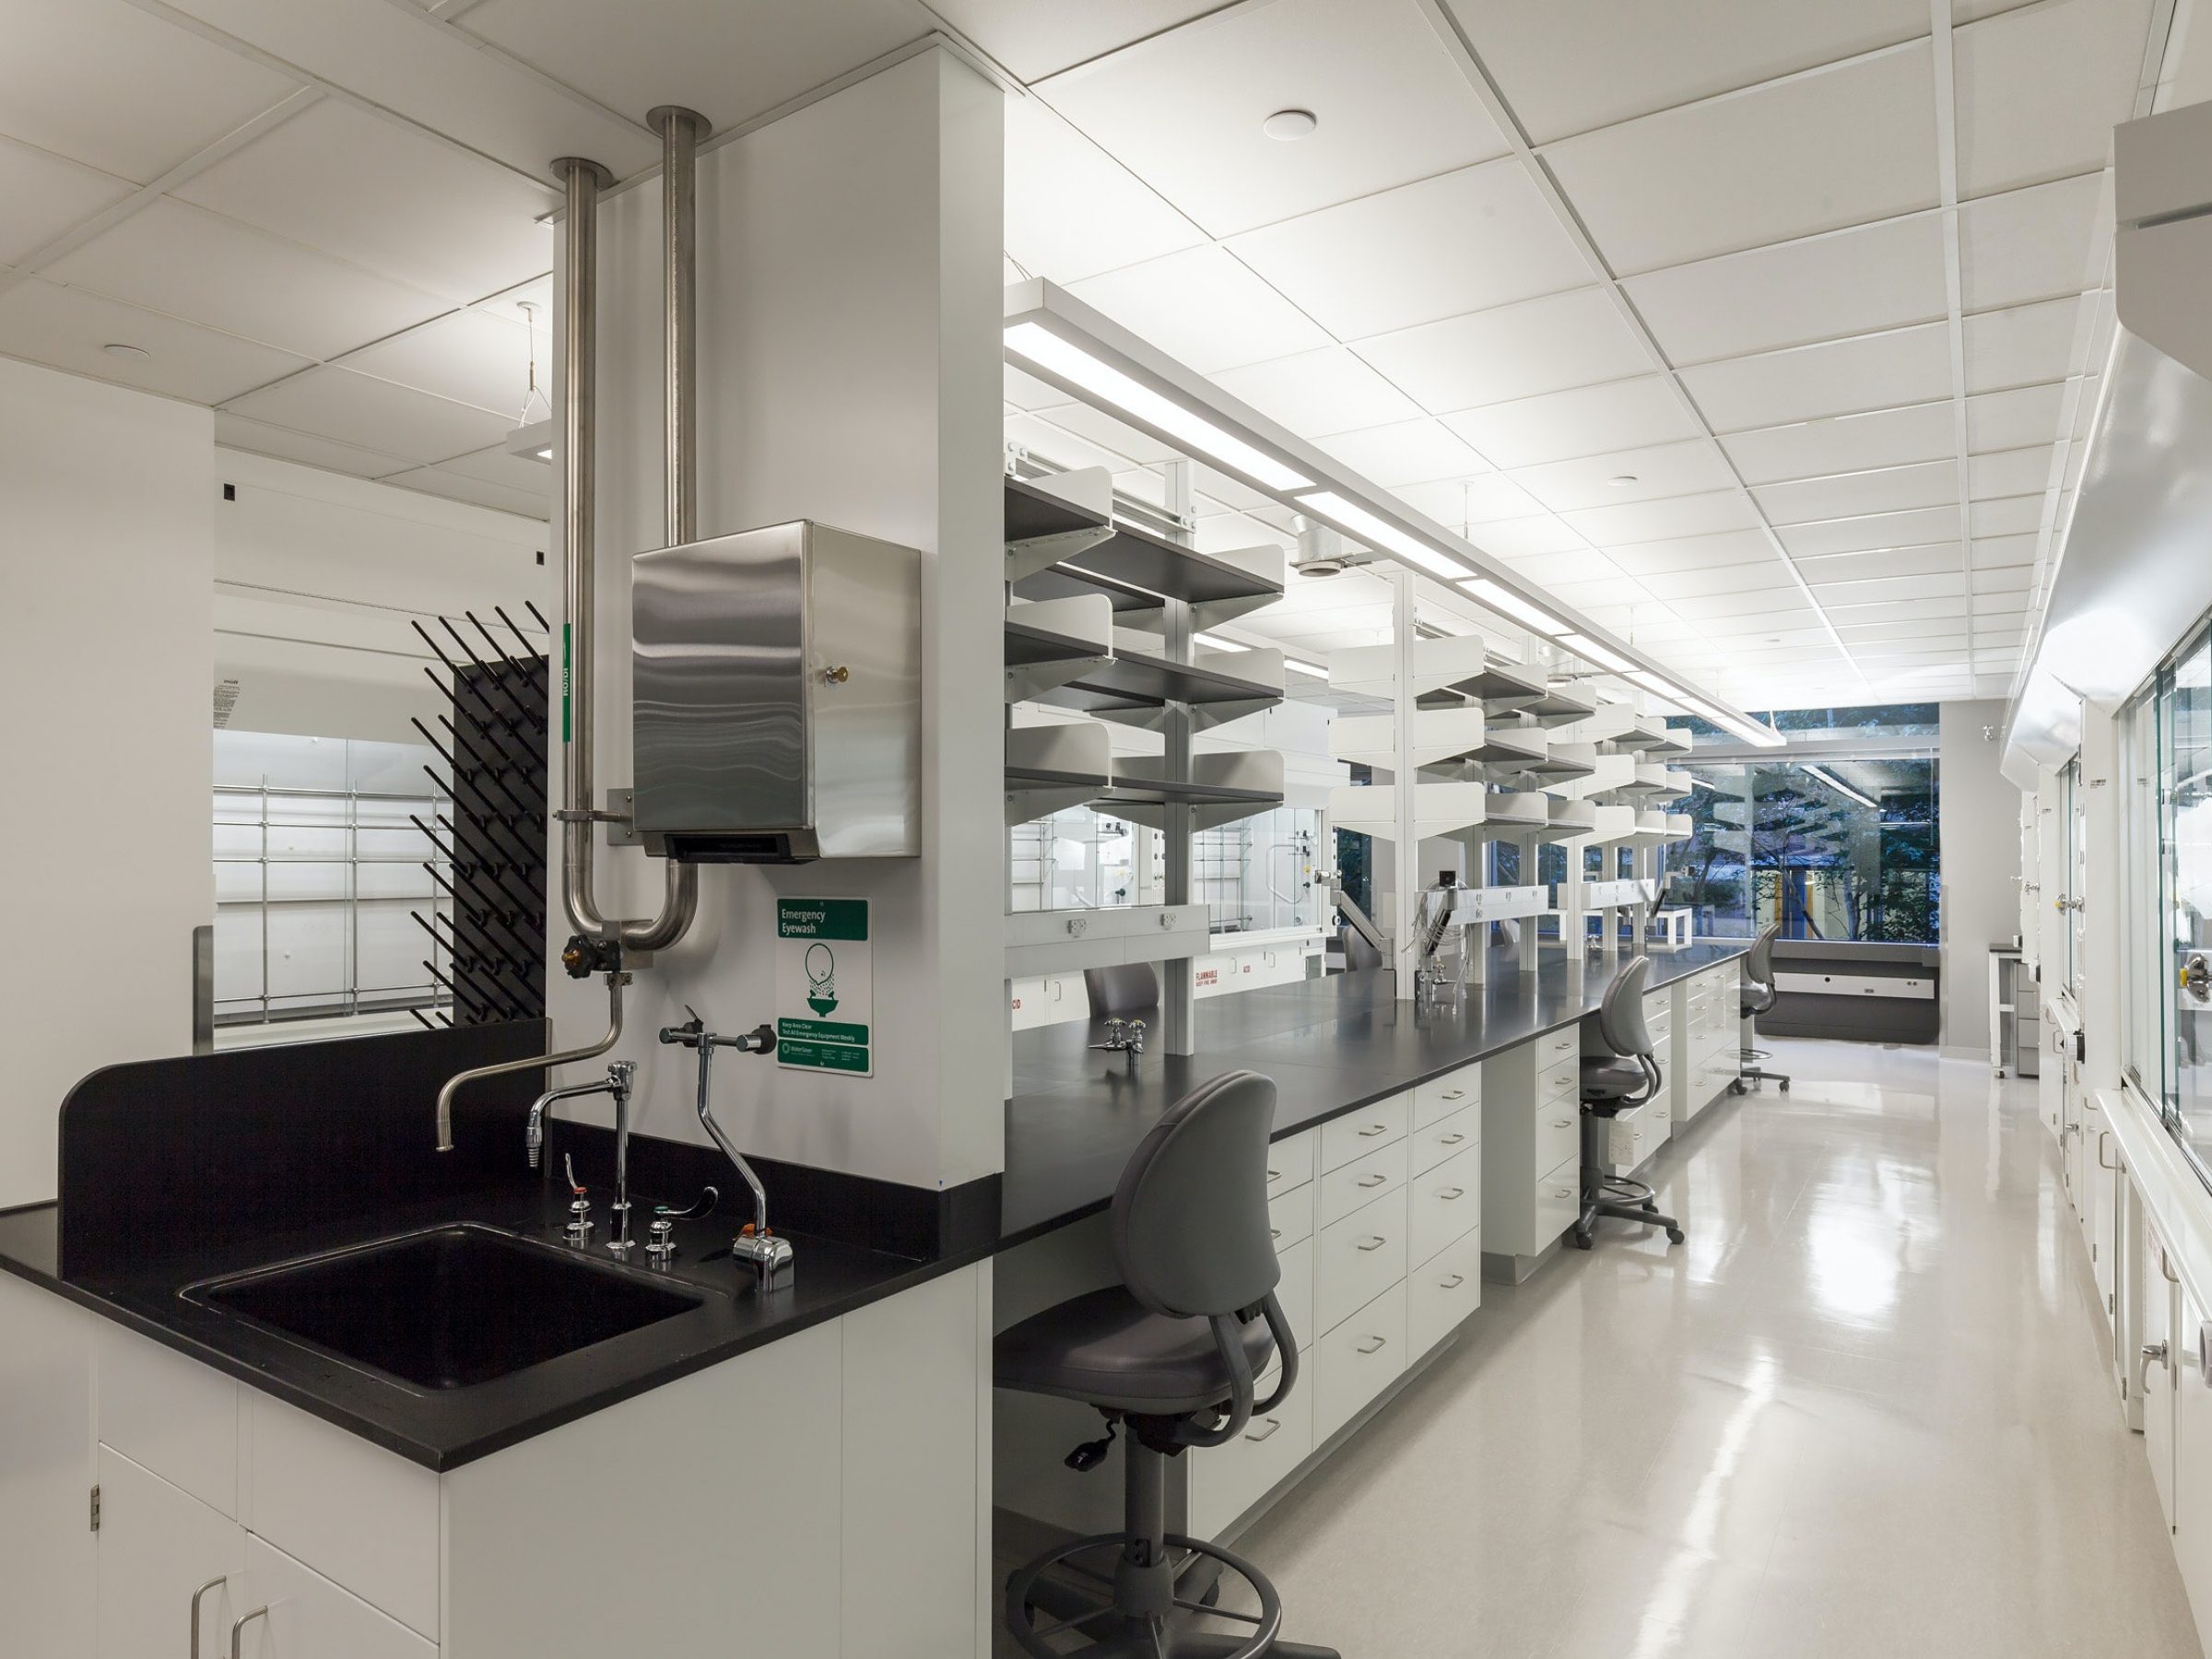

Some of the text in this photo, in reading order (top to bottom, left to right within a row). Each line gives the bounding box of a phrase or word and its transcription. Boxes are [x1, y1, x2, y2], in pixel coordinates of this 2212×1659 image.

[782, 909, 826, 923] Emergency
[782, 923, 817, 935] Eyewash
[1012, 999, 1020, 1009] CID
[796, 1030, 818, 1039] Emergency
[818, 1032, 840, 1041] Equipment
[841, 1034, 855, 1042] Weekly
